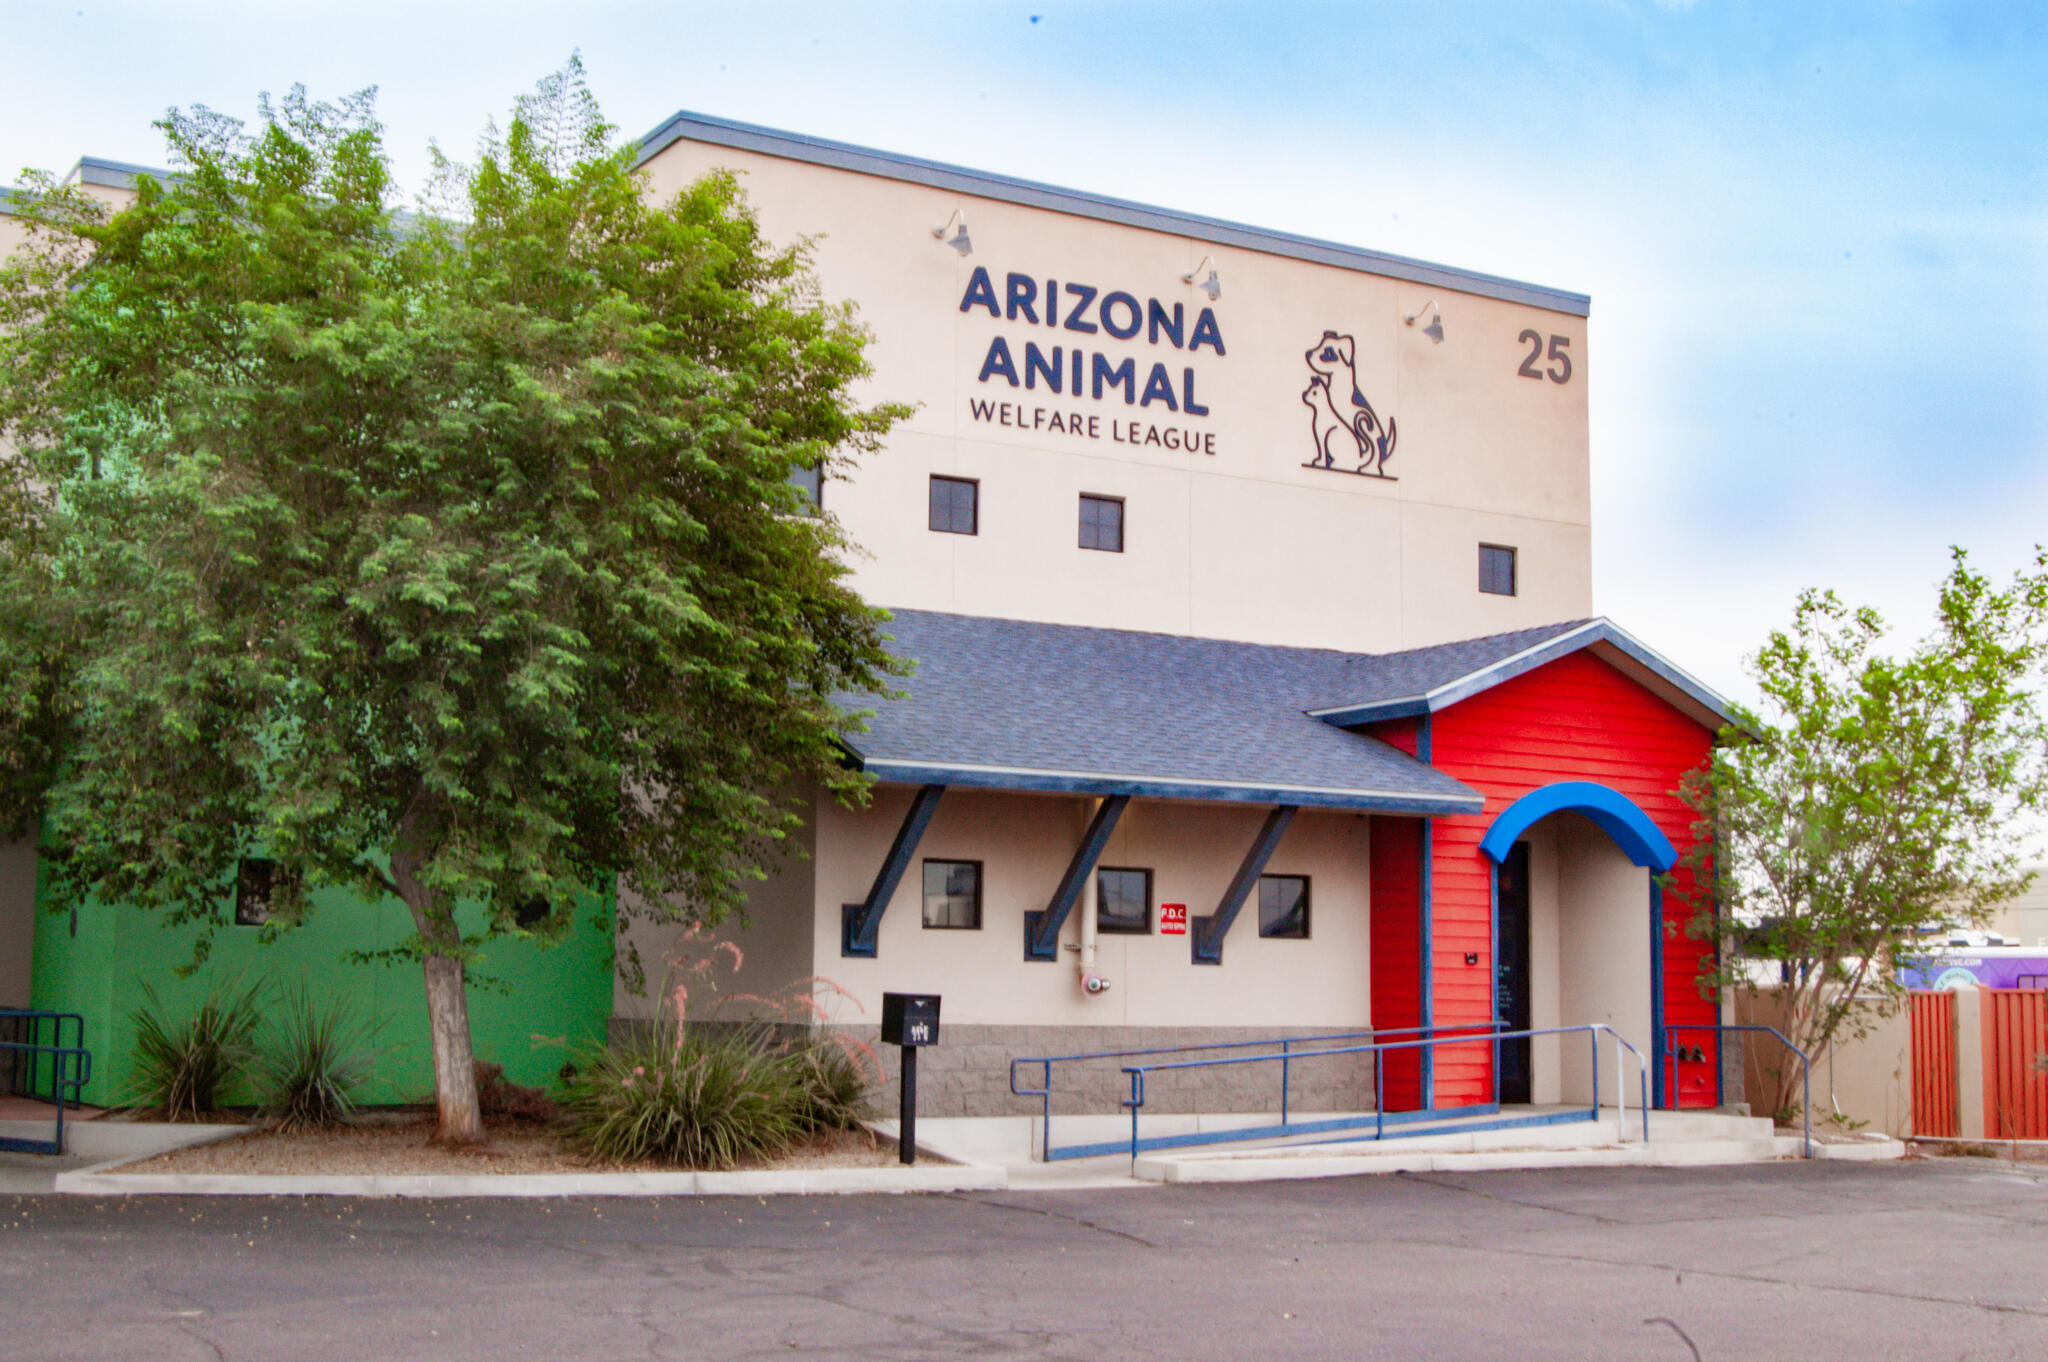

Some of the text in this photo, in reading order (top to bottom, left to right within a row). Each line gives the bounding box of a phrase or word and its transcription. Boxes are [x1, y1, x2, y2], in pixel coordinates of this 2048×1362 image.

[959, 265, 1227, 357] ARIZONA
[978, 335, 1210, 417] ANIMAL
[1517, 328, 1573, 385] 25
[970, 397, 1217, 456] WELFARE LEAGUE
